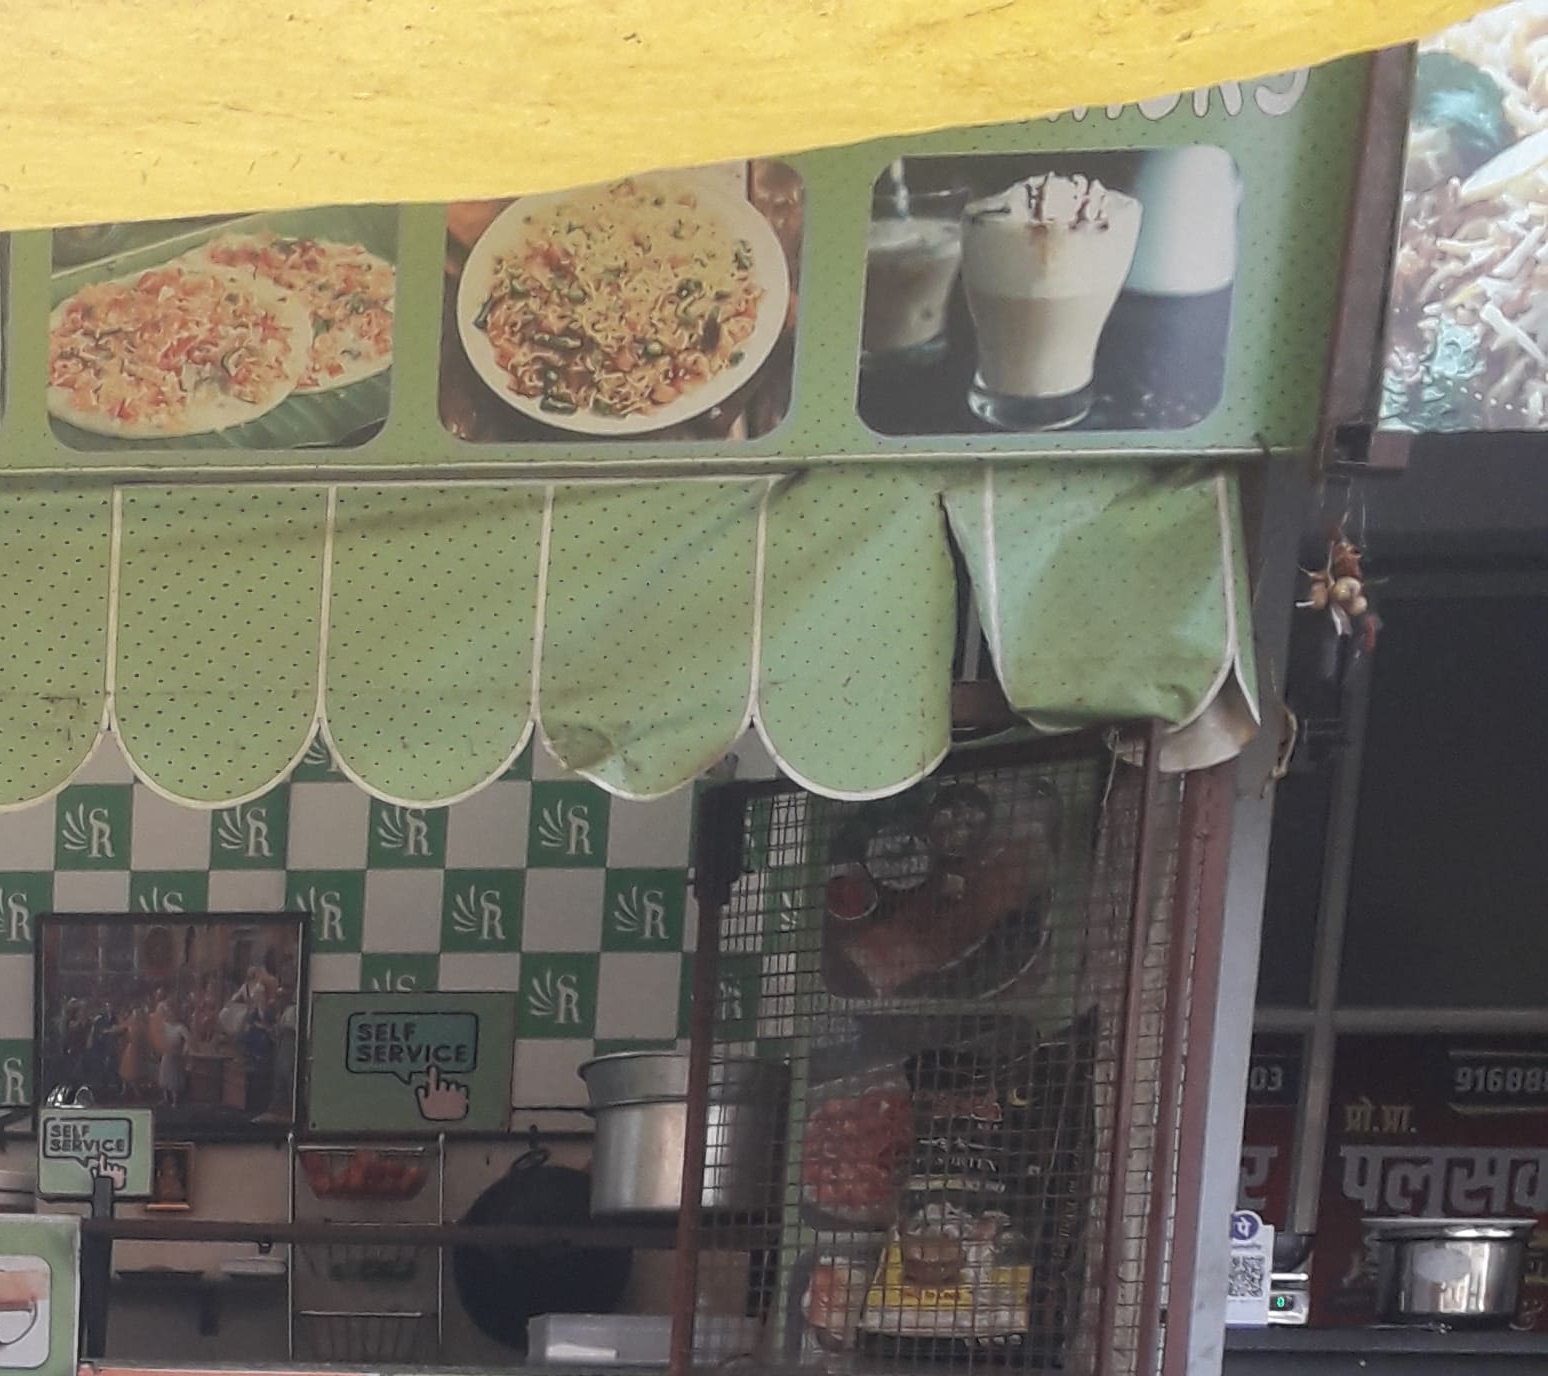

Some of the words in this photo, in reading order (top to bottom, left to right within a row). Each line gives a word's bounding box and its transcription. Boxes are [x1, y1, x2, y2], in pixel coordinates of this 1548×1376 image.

[357, 1023, 416, 1041] SELF
[356, 1044, 467, 1062] SERVICE
[1250, 1066, 1283, 1091] 03
[50, 1125, 90, 1137] SELF
[50, 1139, 125, 1152] SERVICE
